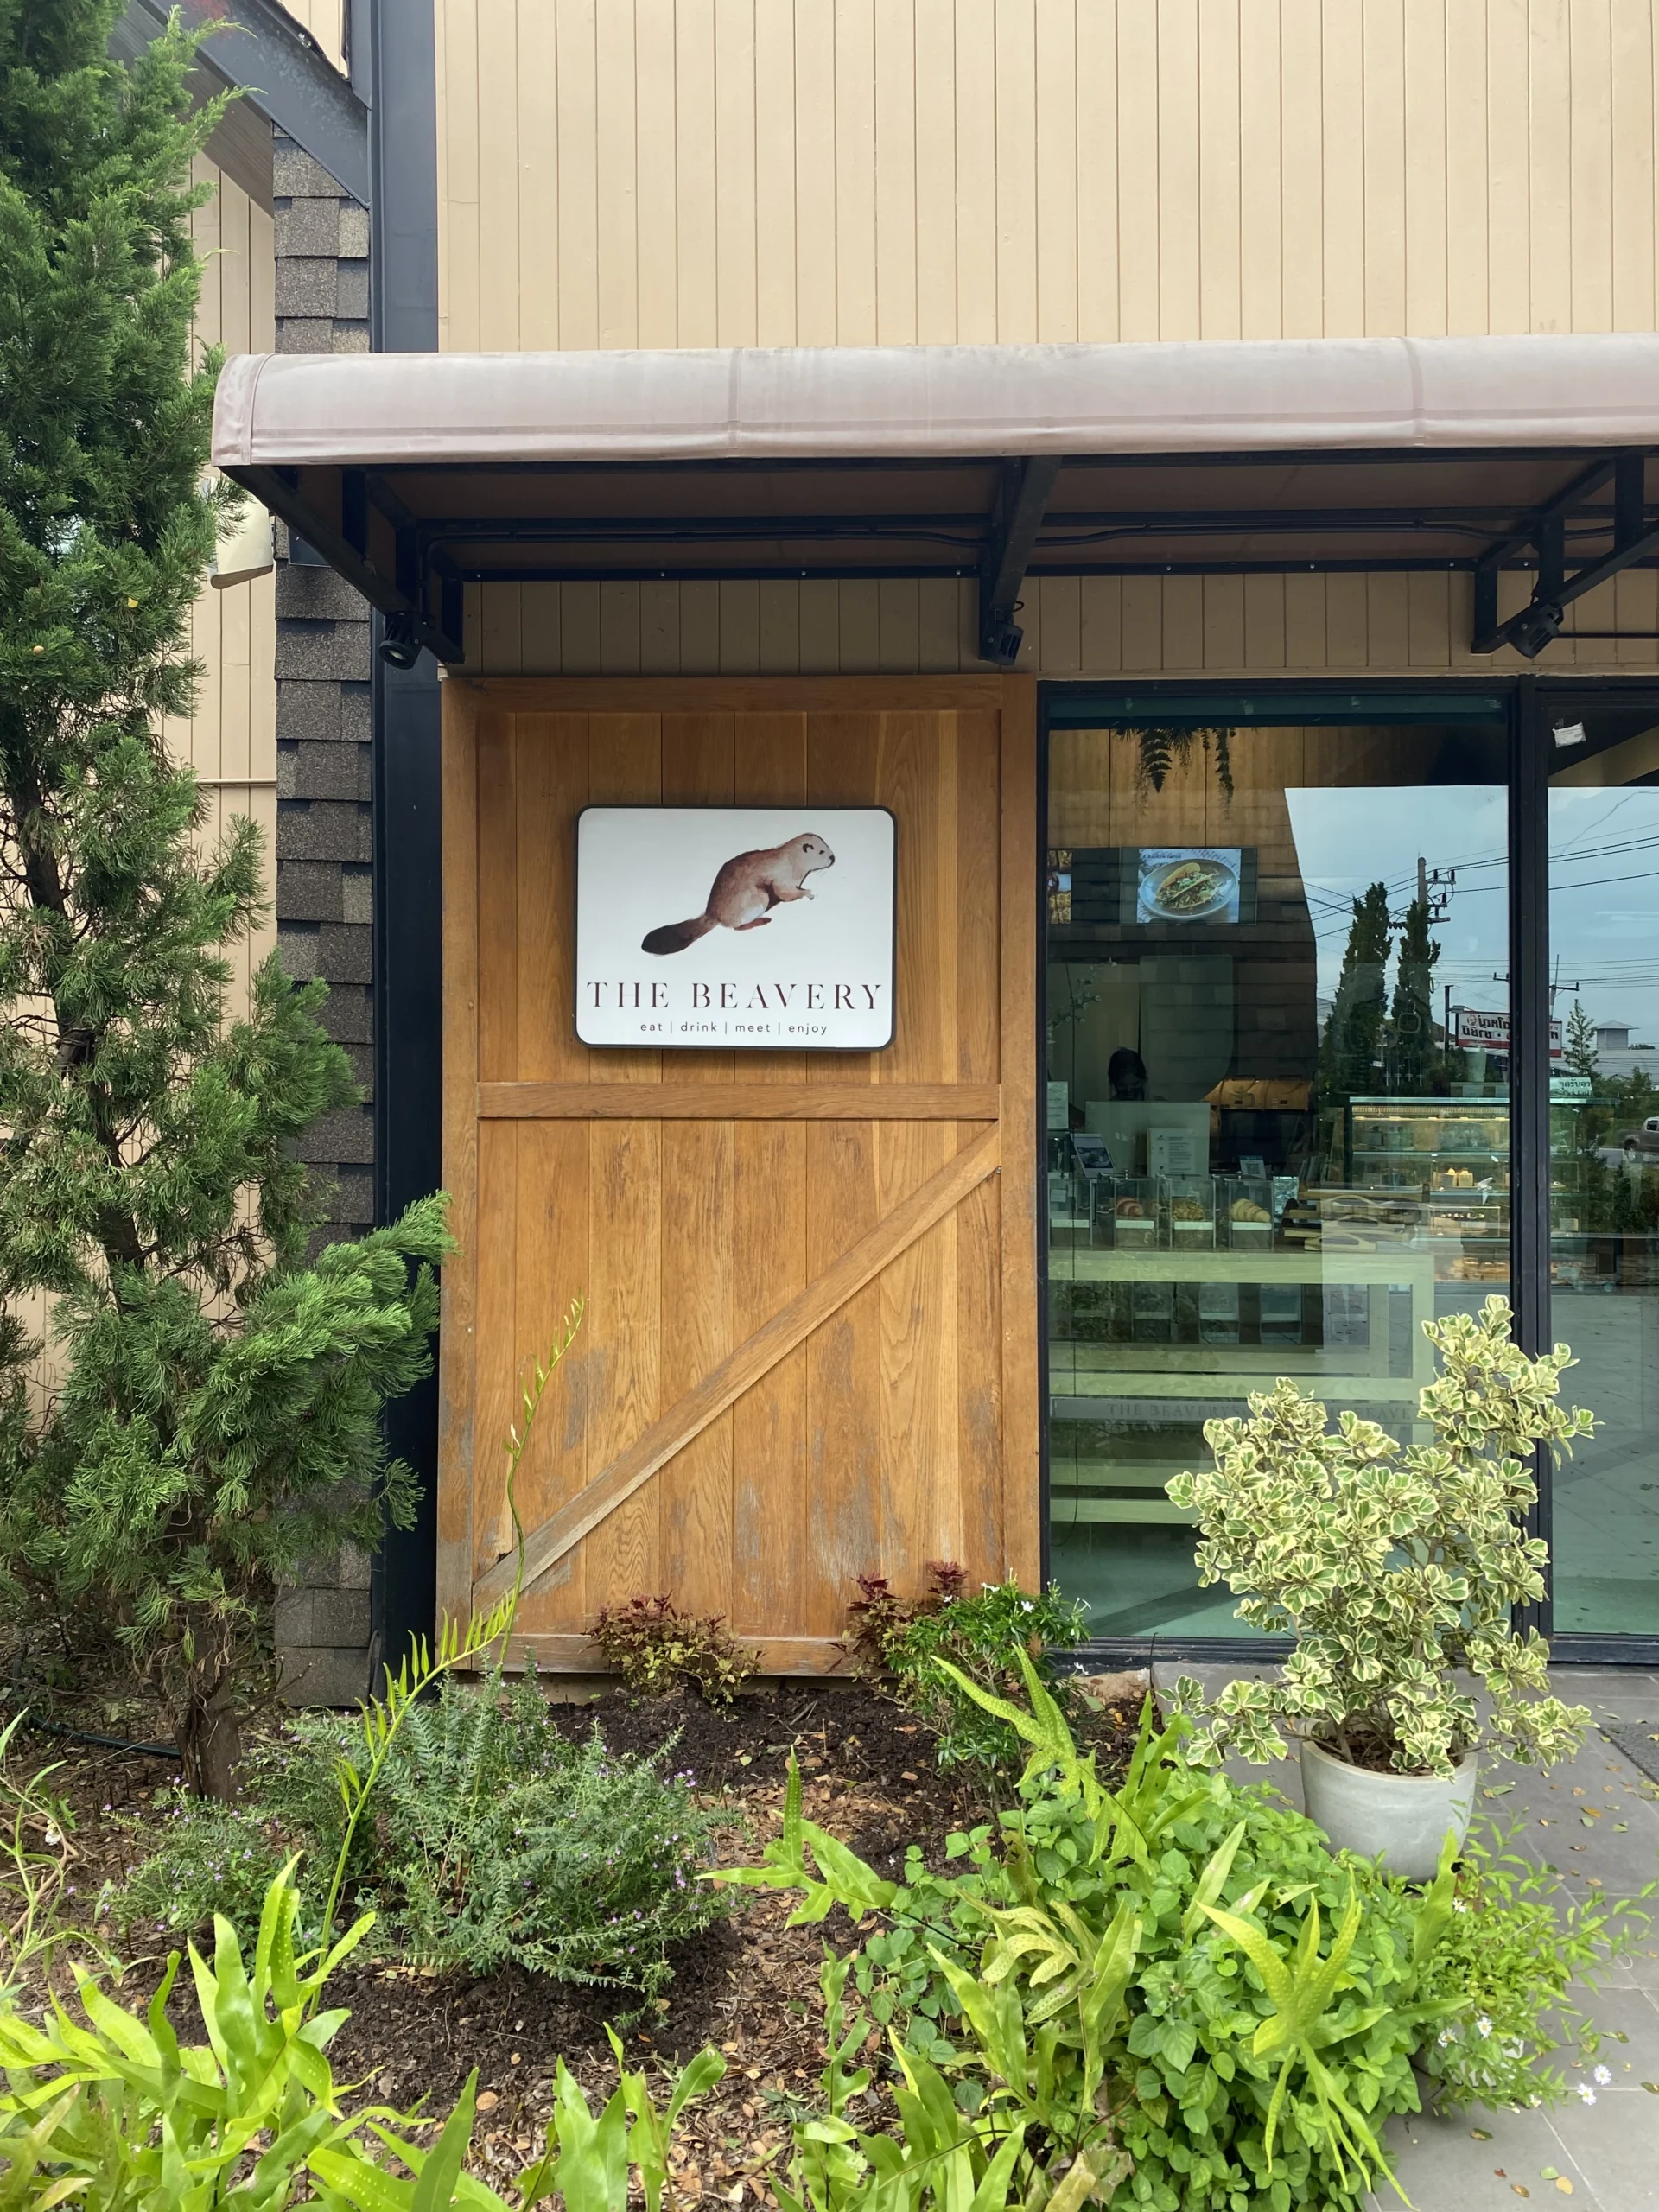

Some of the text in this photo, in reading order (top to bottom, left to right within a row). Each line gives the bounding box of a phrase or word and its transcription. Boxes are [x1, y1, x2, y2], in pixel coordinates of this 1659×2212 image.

[587, 982, 881, 1010] THE BEAVERY
[640, 1022, 827, 1036] eat drink meet enjoy
[1107, 1404, 1230, 1417] THE BEAVERY
